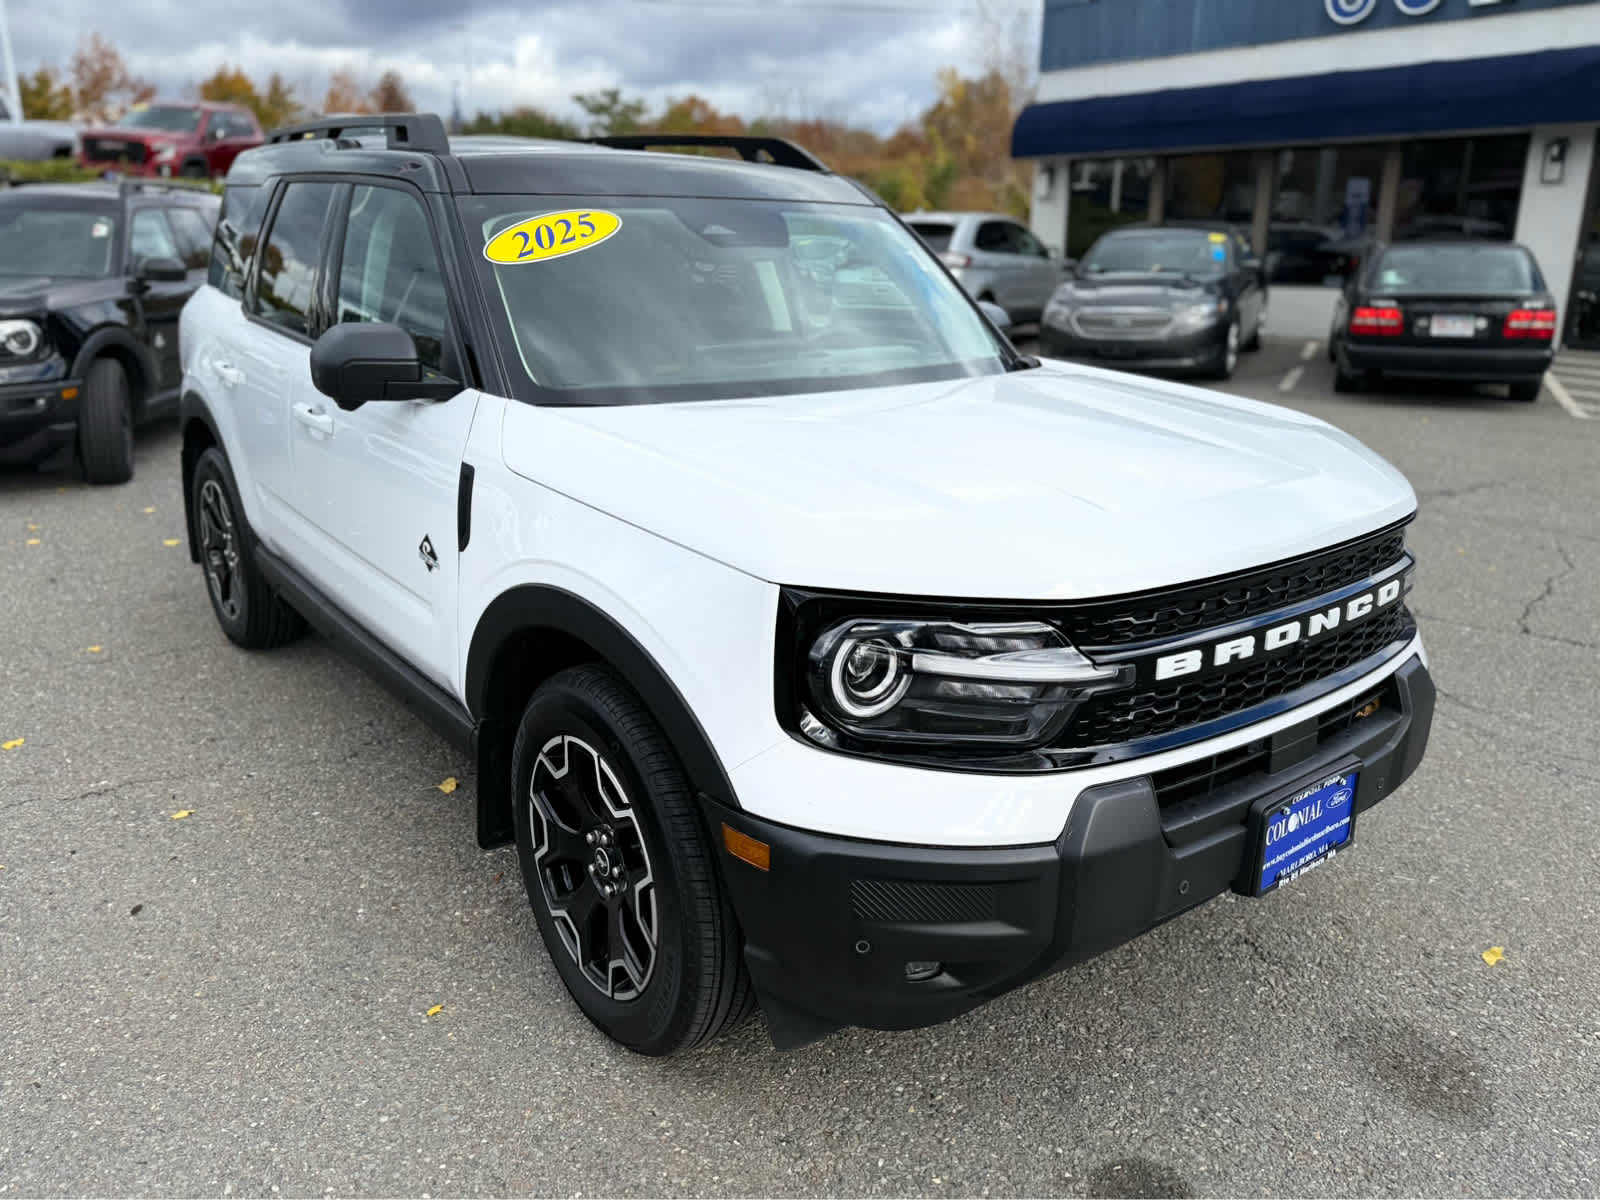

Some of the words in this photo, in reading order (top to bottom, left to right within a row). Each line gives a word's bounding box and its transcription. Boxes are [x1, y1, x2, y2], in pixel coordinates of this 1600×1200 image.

[512, 213, 596, 259] 2025
[1155, 579, 1401, 681] BRONCO
[1330, 790, 1348, 807] Ford
[1265, 799, 1323, 846] COLONIAL
